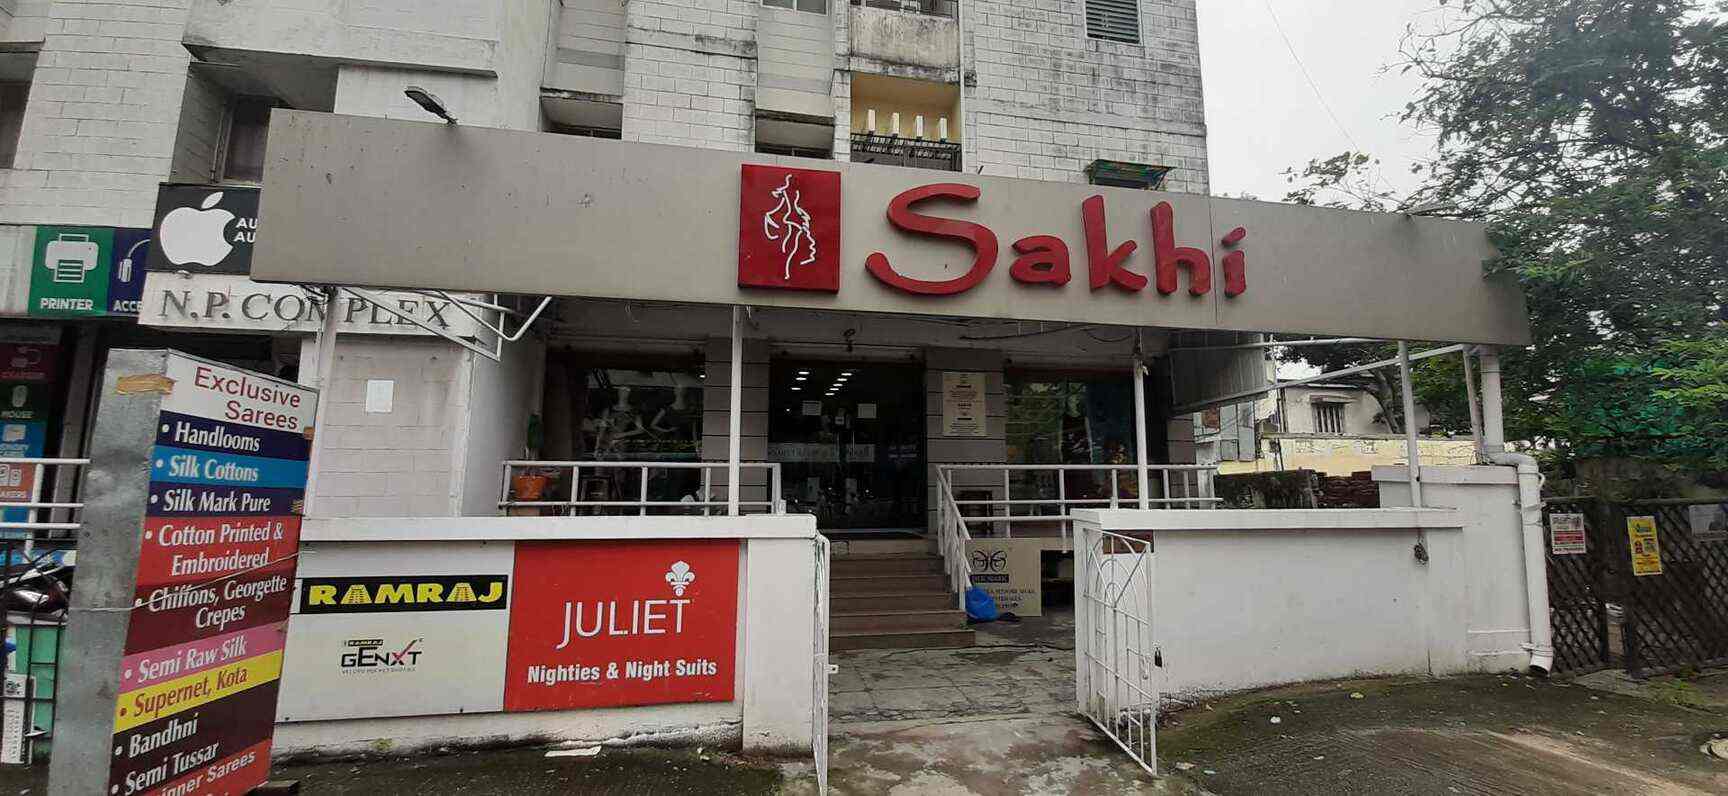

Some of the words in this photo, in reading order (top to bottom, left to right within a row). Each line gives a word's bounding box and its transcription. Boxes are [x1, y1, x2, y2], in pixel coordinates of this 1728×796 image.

[865, 182, 1247, 298] Sakhi
[40, 297, 94, 311] PRINTER
[194, 366, 301, 408] Exclusive
[225, 400, 298, 430] Sarees
[174, 421, 261, 452] Handlooms
[168, 454, 199, 478] Silk
[204, 458, 260, 482] Cottons
[163, 489, 195, 512] Silk
[198, 492, 237, 513] Mark
[241, 494, 271, 512] Pure
[159, 524, 215, 547] Cotton
[219, 521, 271, 544] Printed
[273, 522, 284, 540] &
[171, 547, 270, 577] Embroidered
[148, 584, 219, 612] Chiffons,
[224, 575, 288, 602] Georgette
[309, 582, 504, 606] RAMRAJ
[195, 604, 246, 631] Crepes
[556, 599, 691, 649] JULIET
[137, 650, 181, 684] Semi
[185, 647, 216, 671] Raw
[220, 635, 247, 662] Silk
[527, 664, 600, 686] Nighties
[606, 662, 619, 680] &
[625, 660, 671, 681] Night
[675, 658, 718, 677] Suits
[133, 676, 212, 718] Supernet,
[216, 666, 248, 691] Kota
[129, 712, 198, 758] Bandhni
[125, 756, 168, 796] Semi
[173, 742, 219, 775] Tussar
[206, 750, 256, 783] Sarees
